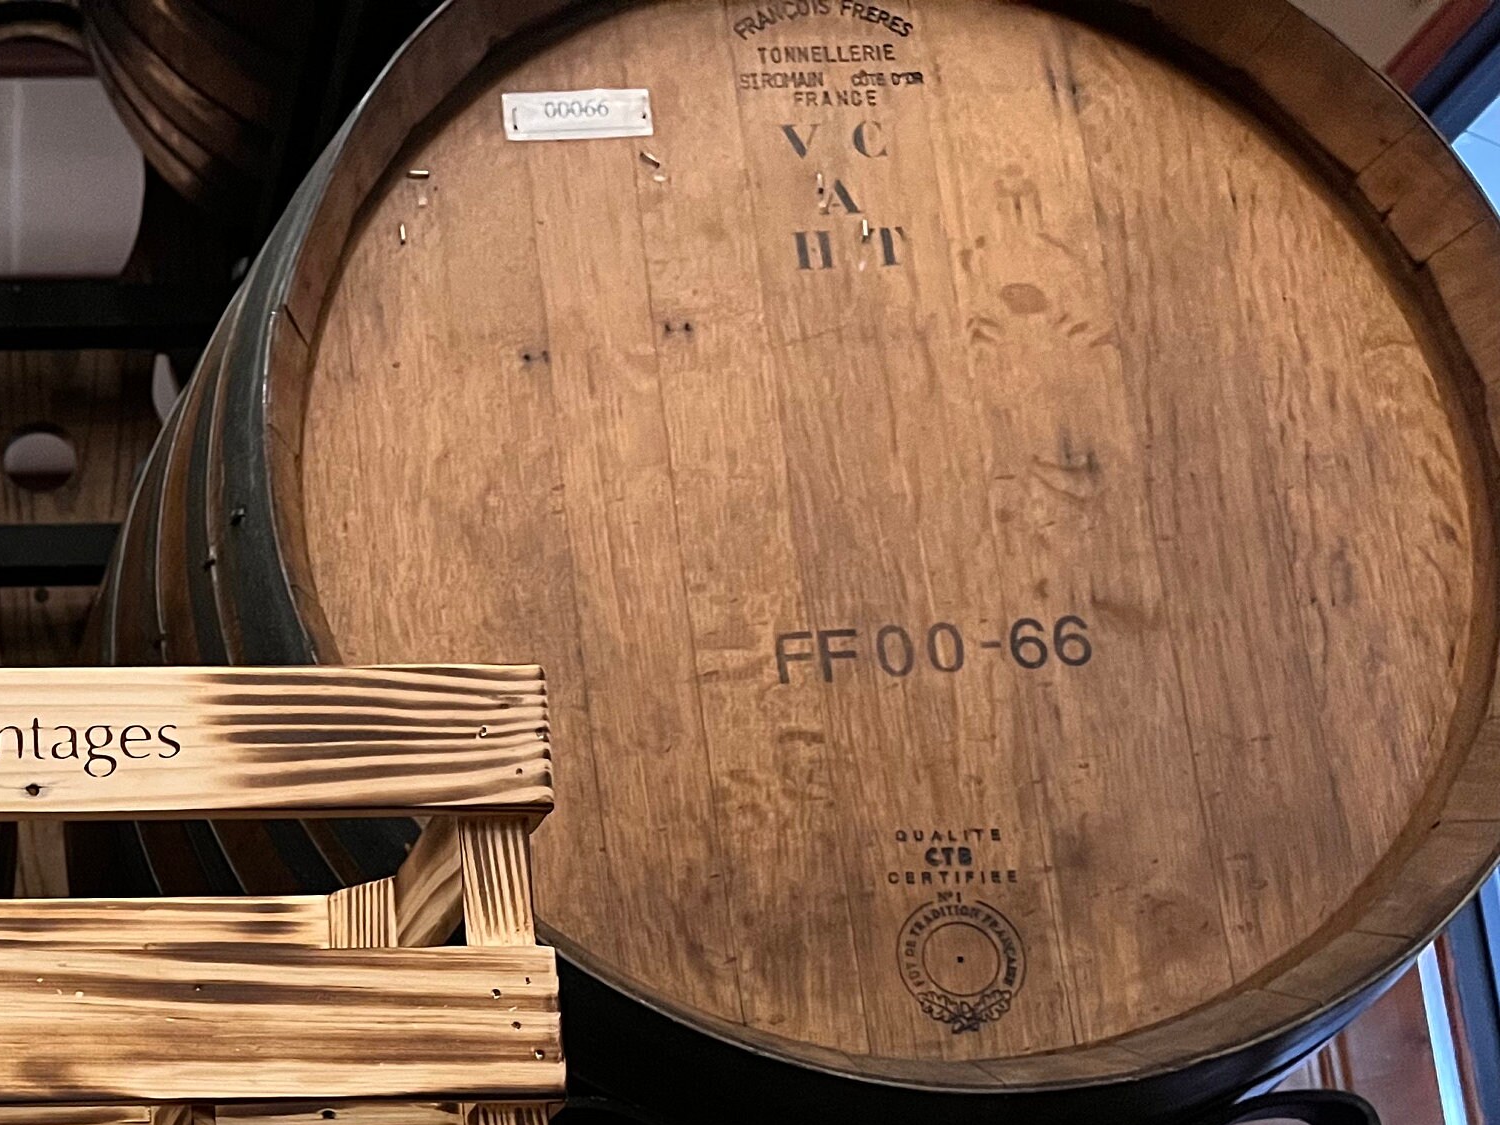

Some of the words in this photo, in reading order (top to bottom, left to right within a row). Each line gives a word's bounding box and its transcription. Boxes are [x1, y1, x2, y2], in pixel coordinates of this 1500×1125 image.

[757, 43, 896, 65] TONNELLERIE
[794, 90, 877, 107] FRANCE
[544, 99, 610, 119] 00066
[819, 179, 862, 215] A
[895, 828, 1001, 842] QUALITE
[925, 847, 972, 866] CTB
[887, 870, 1018, 885] CERTIFIEE
[909, 904, 981, 937] TRADITION
